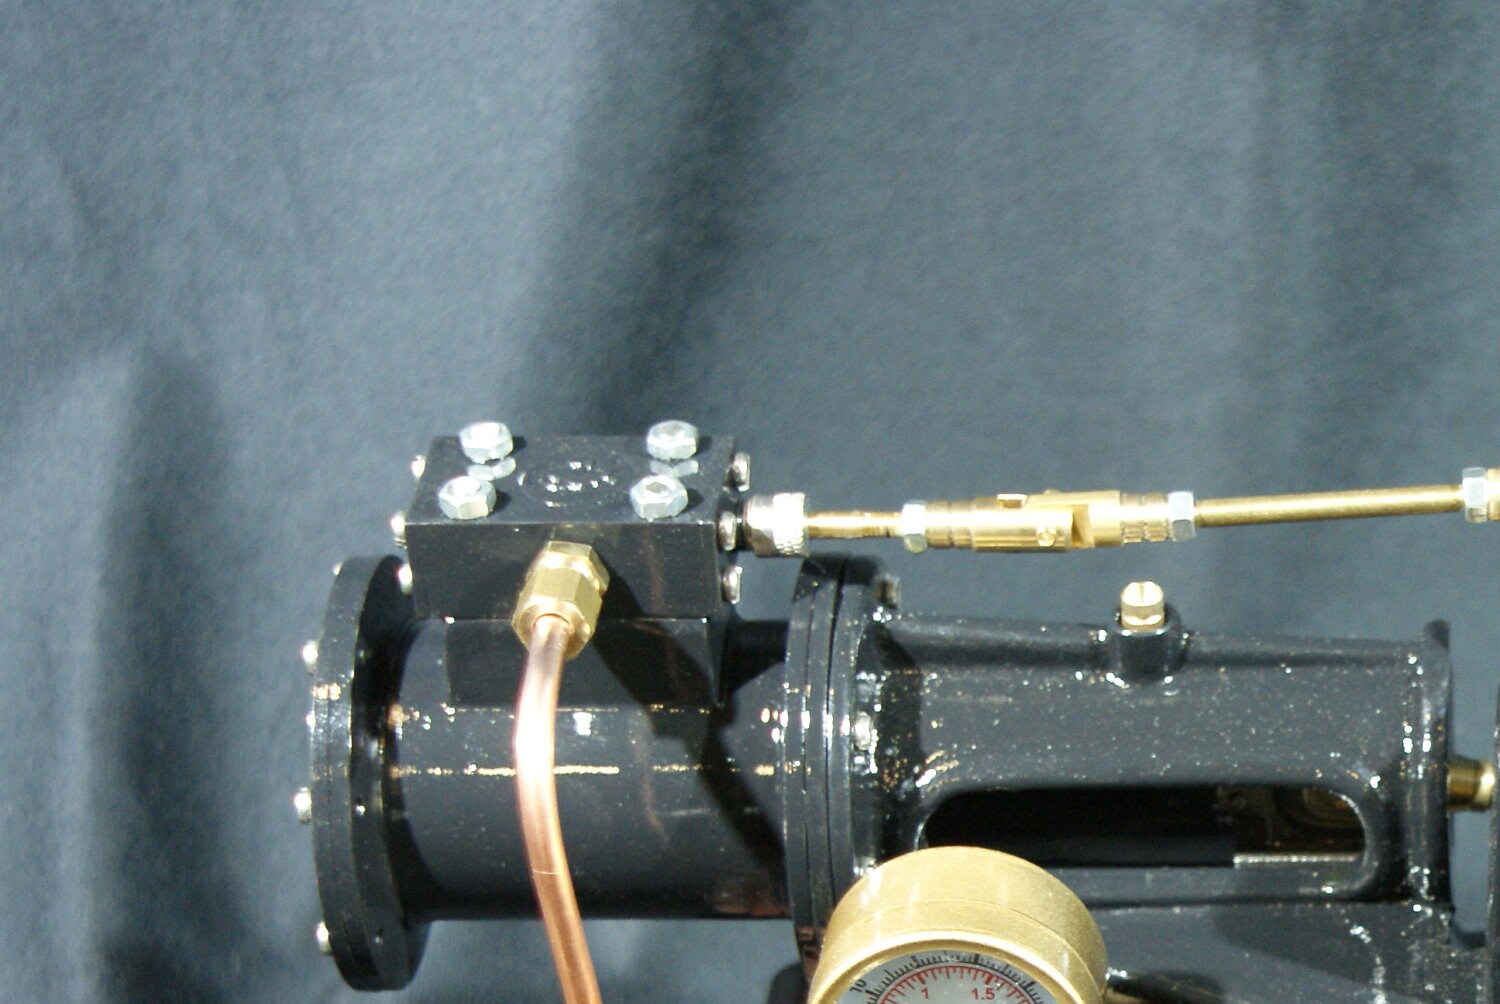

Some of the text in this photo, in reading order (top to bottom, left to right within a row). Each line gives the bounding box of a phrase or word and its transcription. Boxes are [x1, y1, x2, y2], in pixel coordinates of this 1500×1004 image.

[849, 979, 867, 993] 10
[921, 988, 929, 1000] 1
[971, 988, 995, 1001] 1.5
